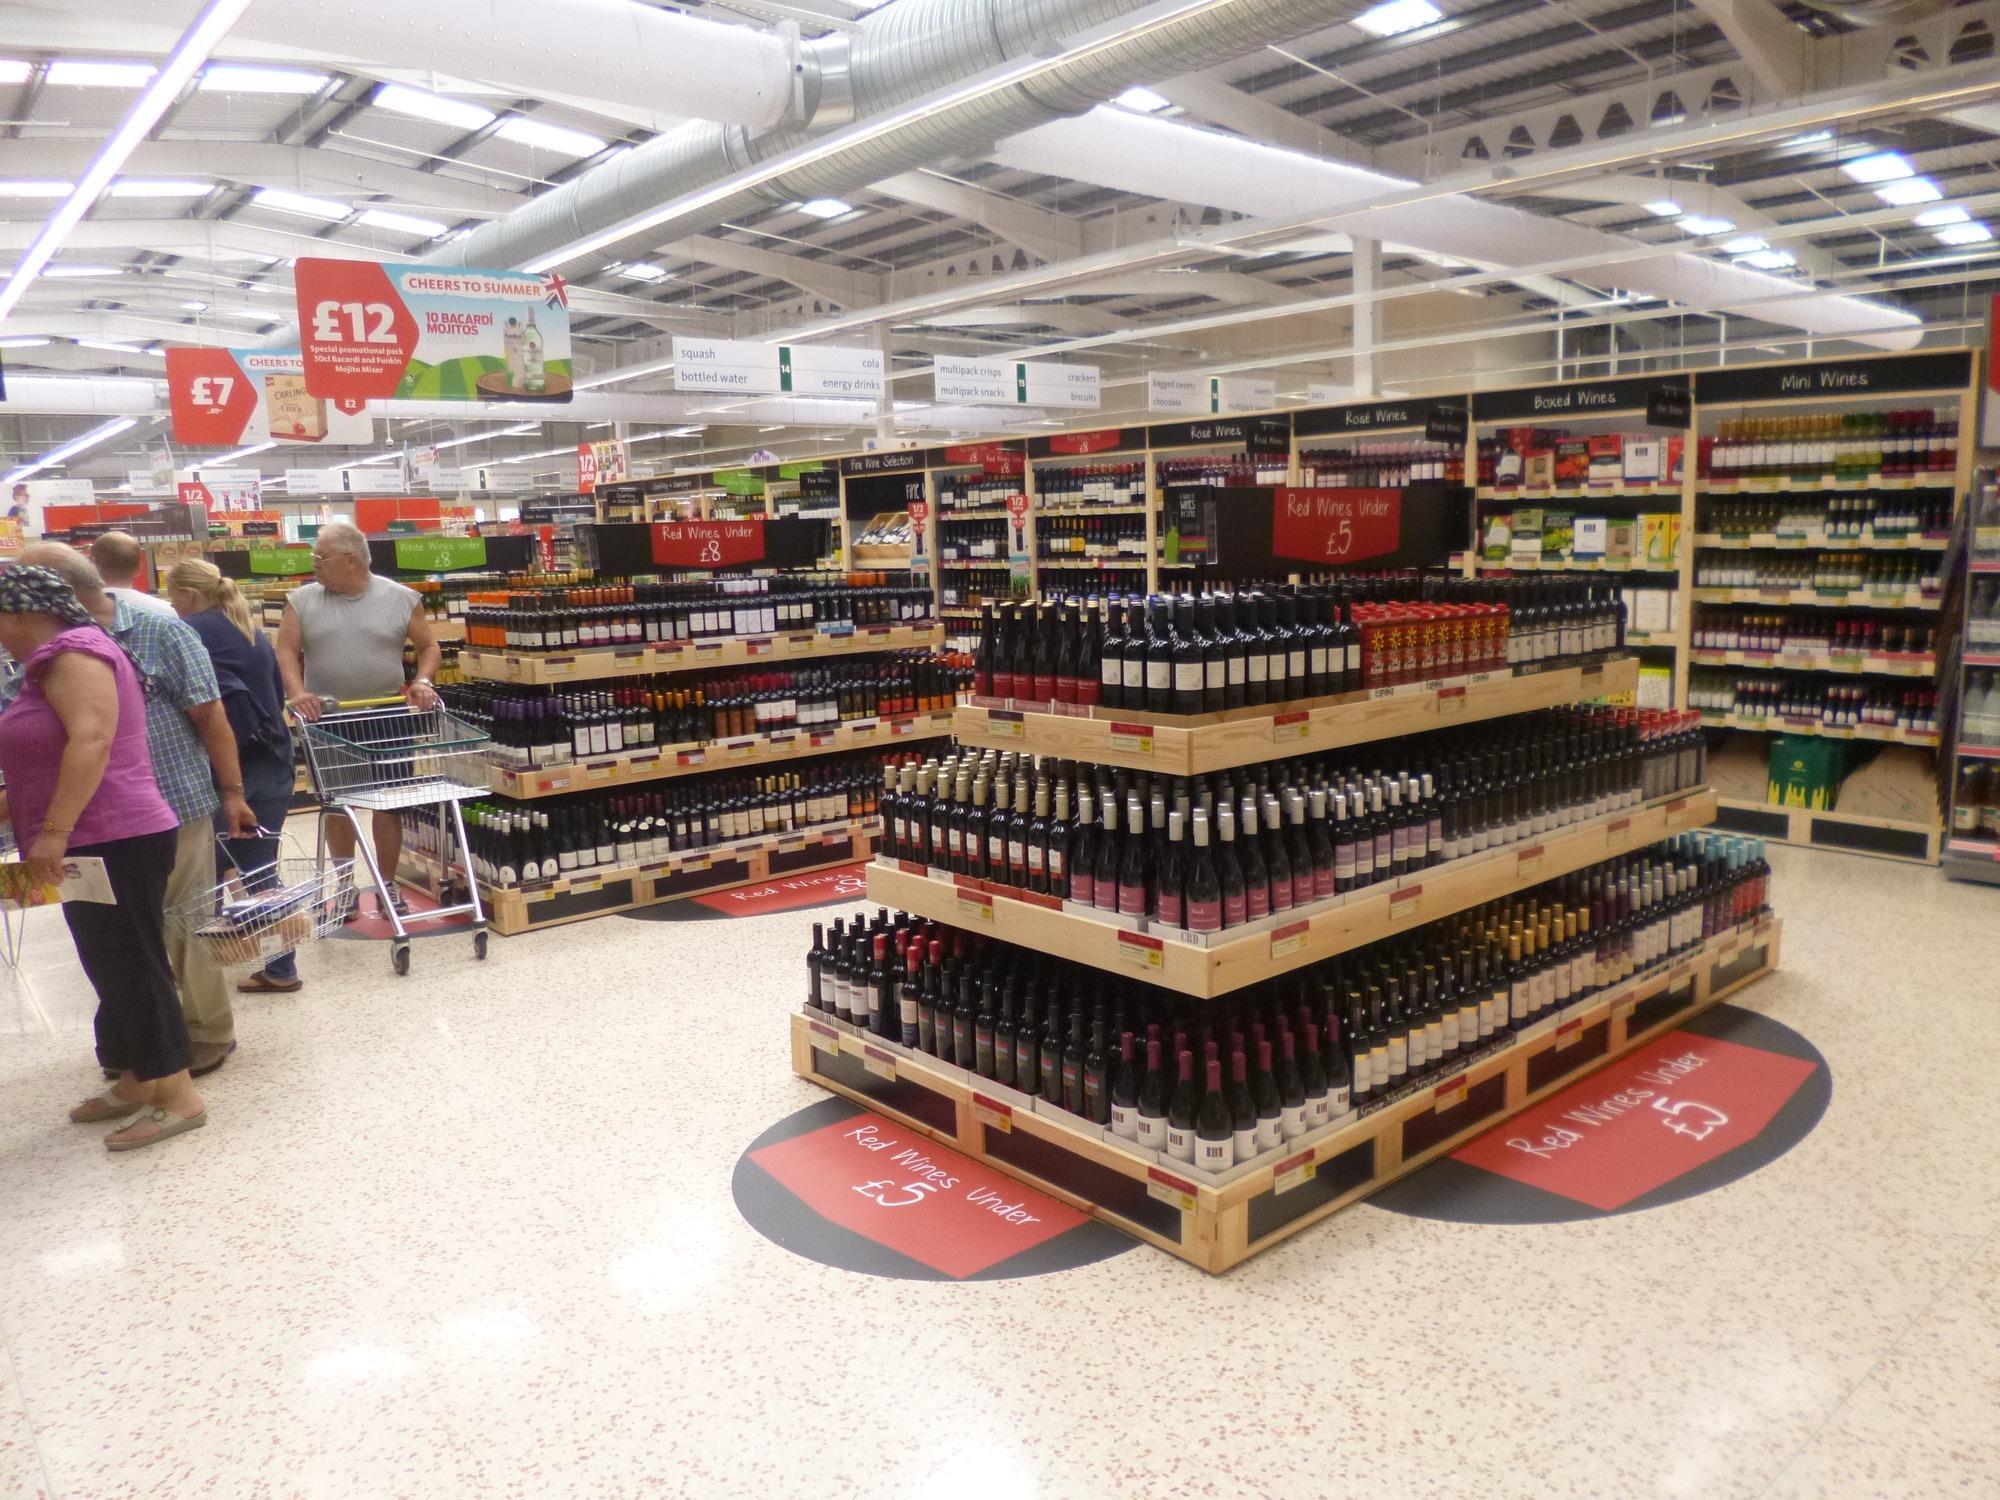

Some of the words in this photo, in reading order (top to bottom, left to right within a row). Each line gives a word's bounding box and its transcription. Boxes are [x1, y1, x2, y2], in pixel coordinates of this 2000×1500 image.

[408, 277, 460, 291] CHEERS
[463, 280, 482, 292] TO
[484, 282, 541, 296] SUMMER
[312, 300, 398, 344] £12
[426, 312, 439, 324] 10
[440, 311, 494, 326] BACARDÍ
[426, 323, 479, 336] MOJITOS
[310, 344, 338, 355] Special
[339, 345, 384, 356] promotional
[386, 346, 404, 357] pack
[681, 348, 716, 361] squash
[249, 358, 288, 368] CHEERS
[289, 359, 304, 368] TO
[314, 354, 331, 364] 50cl
[332, 356, 360, 364] Bacardi
[361, 356, 376, 364] and
[377, 356, 402, 365] Funkin
[862, 359, 880, 368] cola
[336, 365, 365, 375] Mojito
[366, 365, 384, 374] Mixer
[781, 365, 790, 374] 14
[940, 364, 978, 378] multipack
[980, 368, 1002, 378] crisps
[682, 371, 718, 384] bottled
[720, 374, 748, 384] water
[1019, 378, 1026, 388] 15
[1068, 373, 1096, 383] crackers
[1781, 374, 1812, 391] Mini
[1820, 371, 1869, 388] Wines
[191, 376, 234, 406] £7
[822, 379, 853, 392] energy
[854, 378, 880, 390] drinks
[1152, 379, 1175, 390] bagged
[1176, 382, 1196, 390] sweets
[274, 388, 306, 400] CARLING
[941, 385, 980, 398] multipack
[981, 388, 1006, 398] snacks
[1070, 392, 1097, 402] biscuits
[1153, 398, 1182, 407] chocolate
[1534, 391, 1571, 410] Boxed
[1577, 390, 1616, 406] Wines
[1346, 410, 1370, 426] Rosé
[1374, 409, 1408, 424] Wines
[1215, 424, 1242, 437] Wines
[578, 456, 594, 472] 1/2
[850, 458, 863, 471] Fine
[865, 458, 880, 470] Wine
[884, 456, 914, 467] Selection
[582, 470, 594, 482] price
[184, 490, 204, 500] 1/2
[1012, 496, 1024, 506] 1/2
[913, 504, 924, 512] 1/2
[1288, 494, 1311, 517] Red
[1317, 496, 1353, 518] Wines
[1359, 493, 1390, 516] Under
[662, 526, 682, 540] Red
[688, 526, 720, 540] Wines
[725, 526, 754, 539] Under
[1326, 520, 1353, 555] £5
[428, 540, 454, 550] Wines
[458, 541, 481, 550] Under
[700, 540, 722, 562] £8
[281, 558, 296, 572] £5
[434, 552, 452, 568] £8
[730, 887, 780, 900] Red
[782, 874, 854, 890] Wines
[1506, 1124, 1584, 1160] Red
[1562, 1085, 1655, 1130] Wines
[1636, 1050, 1710, 1086] Under
[1651, 1095, 1730, 1142] £5
[844, 1125, 886, 1152] Red
[890, 1148, 960, 1190] Wines
[966, 1186, 1041, 1226] Under
[852, 1178, 938, 1208] £5
